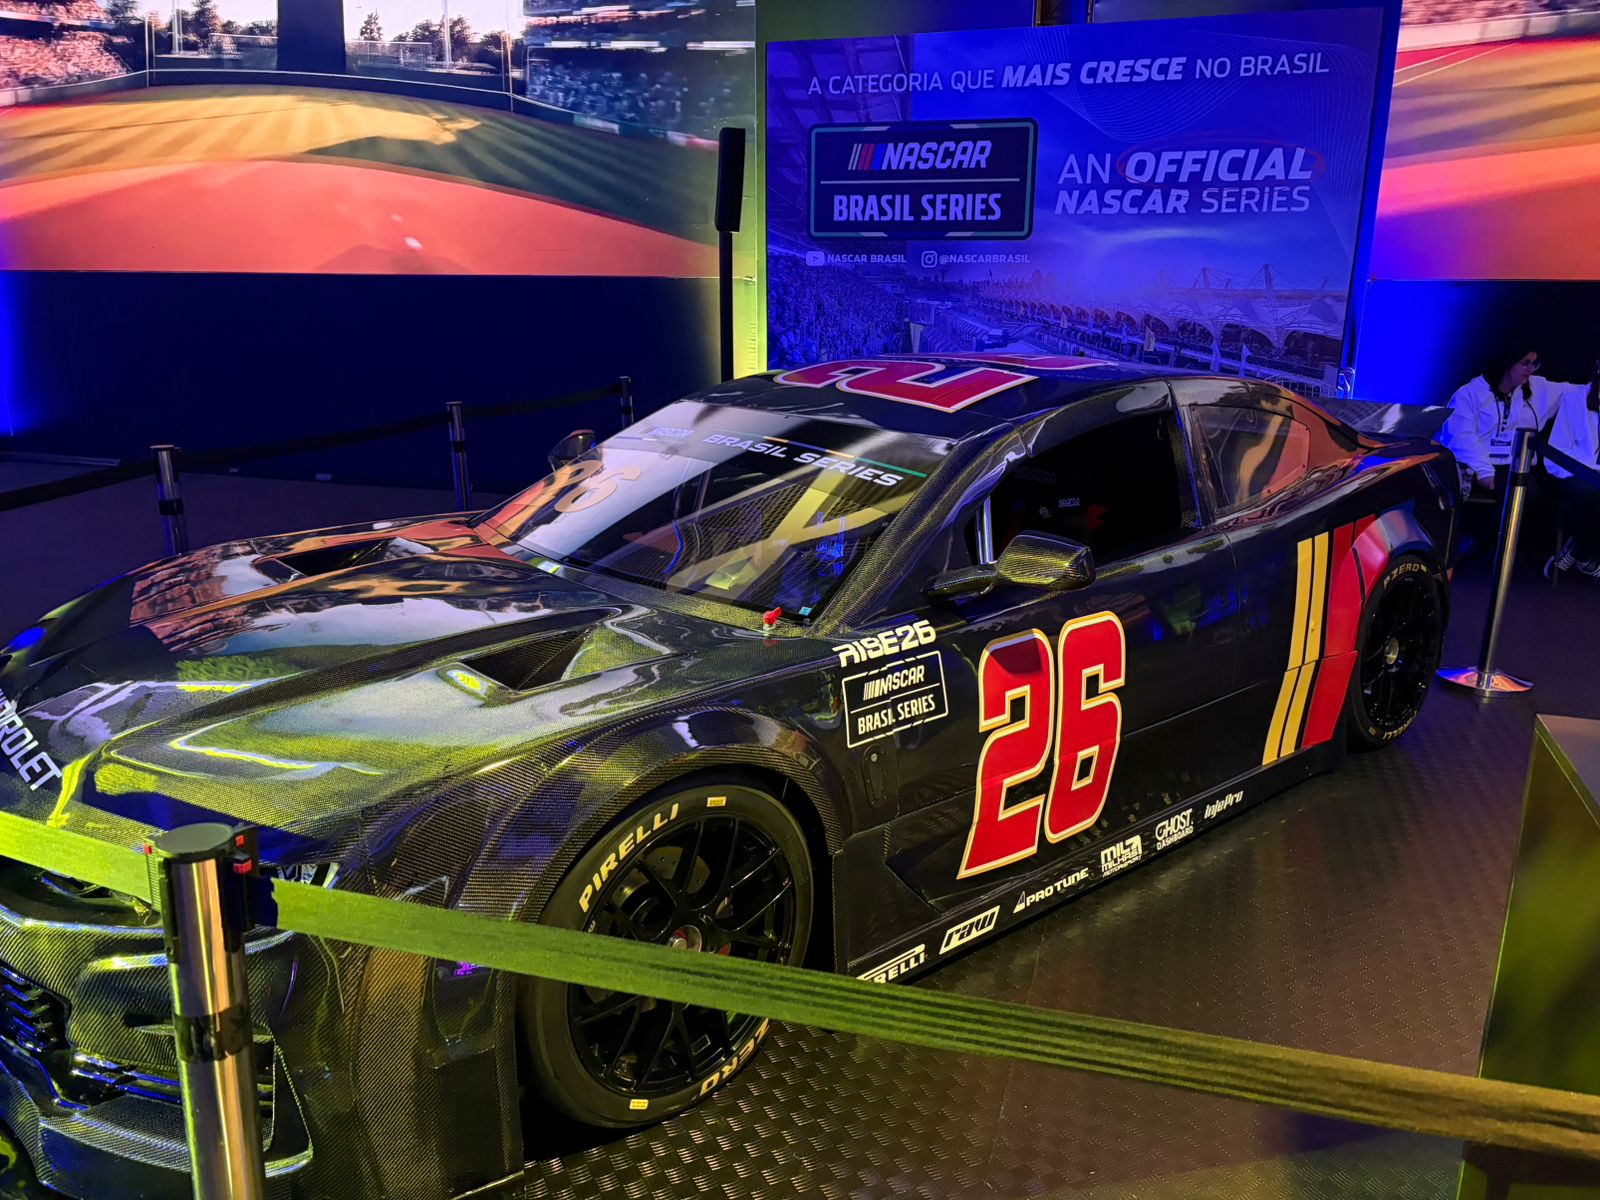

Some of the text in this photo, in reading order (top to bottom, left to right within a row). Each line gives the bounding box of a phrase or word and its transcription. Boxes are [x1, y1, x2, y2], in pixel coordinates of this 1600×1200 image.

[808, 52, 1330, 95] A CATEGORIA QUE MAIS CRESCE NO BRASIL
[881, 140, 992, 171] NASCAR
[1057, 147, 1314, 185] AN OFFICIAL
[833, 193, 1002, 222] BRASIL SERIES
[1054, 185, 1311, 215] NASCAR SERIES
[827, 254, 907, 264] NASCAR BRASIL
[939, 254, 1031, 265] @NASCARBRASIL
[703, 433, 904, 488] BRASIL SERIES
[878, 664, 925, 697] NASCAR
[897, 694, 935, 721] SERIES
[956, 610, 1126, 880] 26
[1156, 825, 1194, 851] DASHBOARD
[579, 803, 679, 913] PIRELLI
